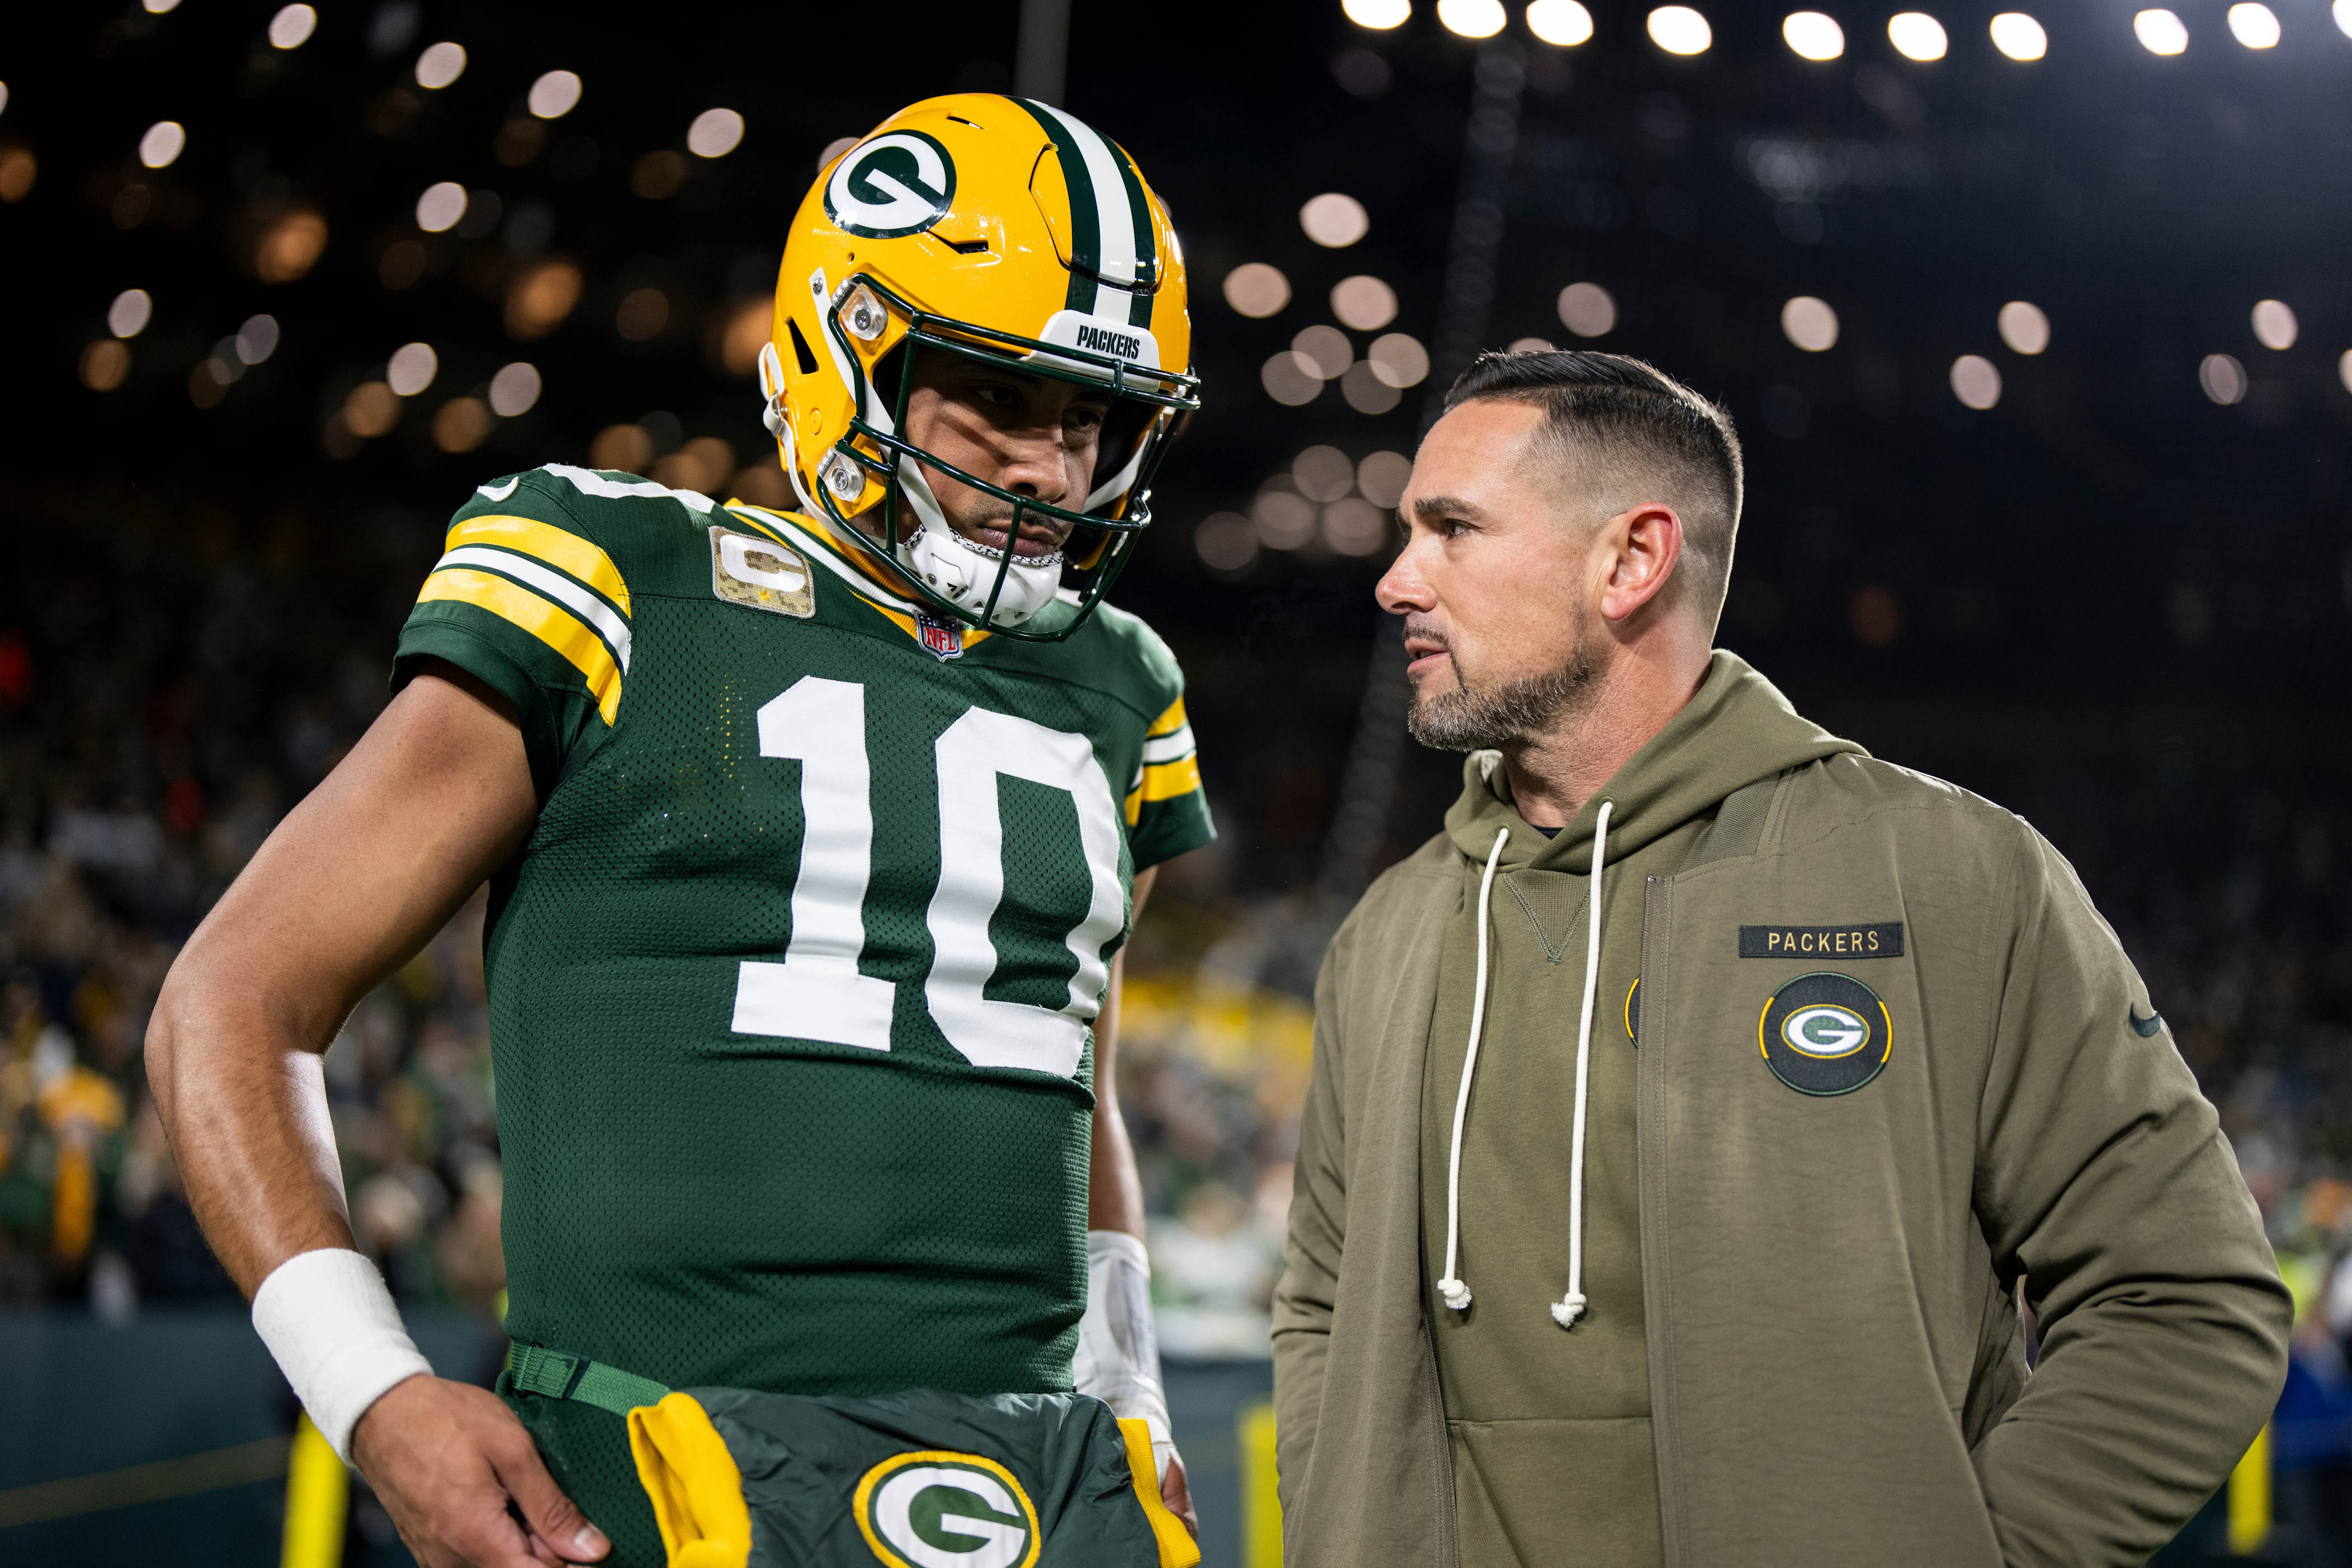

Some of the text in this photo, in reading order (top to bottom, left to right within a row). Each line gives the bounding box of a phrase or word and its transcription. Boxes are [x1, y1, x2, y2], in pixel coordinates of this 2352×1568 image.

[829, 134, 946, 230] G
[1076, 325, 1140, 360] PACKERS
[720, 535, 805, 592] C
[924, 626, 956, 651] NFL
[730, 675, 1124, 1079] 10
[1768, 931, 1879, 952] PACKERS
[1788, 1009, 1863, 1052] G
[875, 1466, 1026, 1568] G
